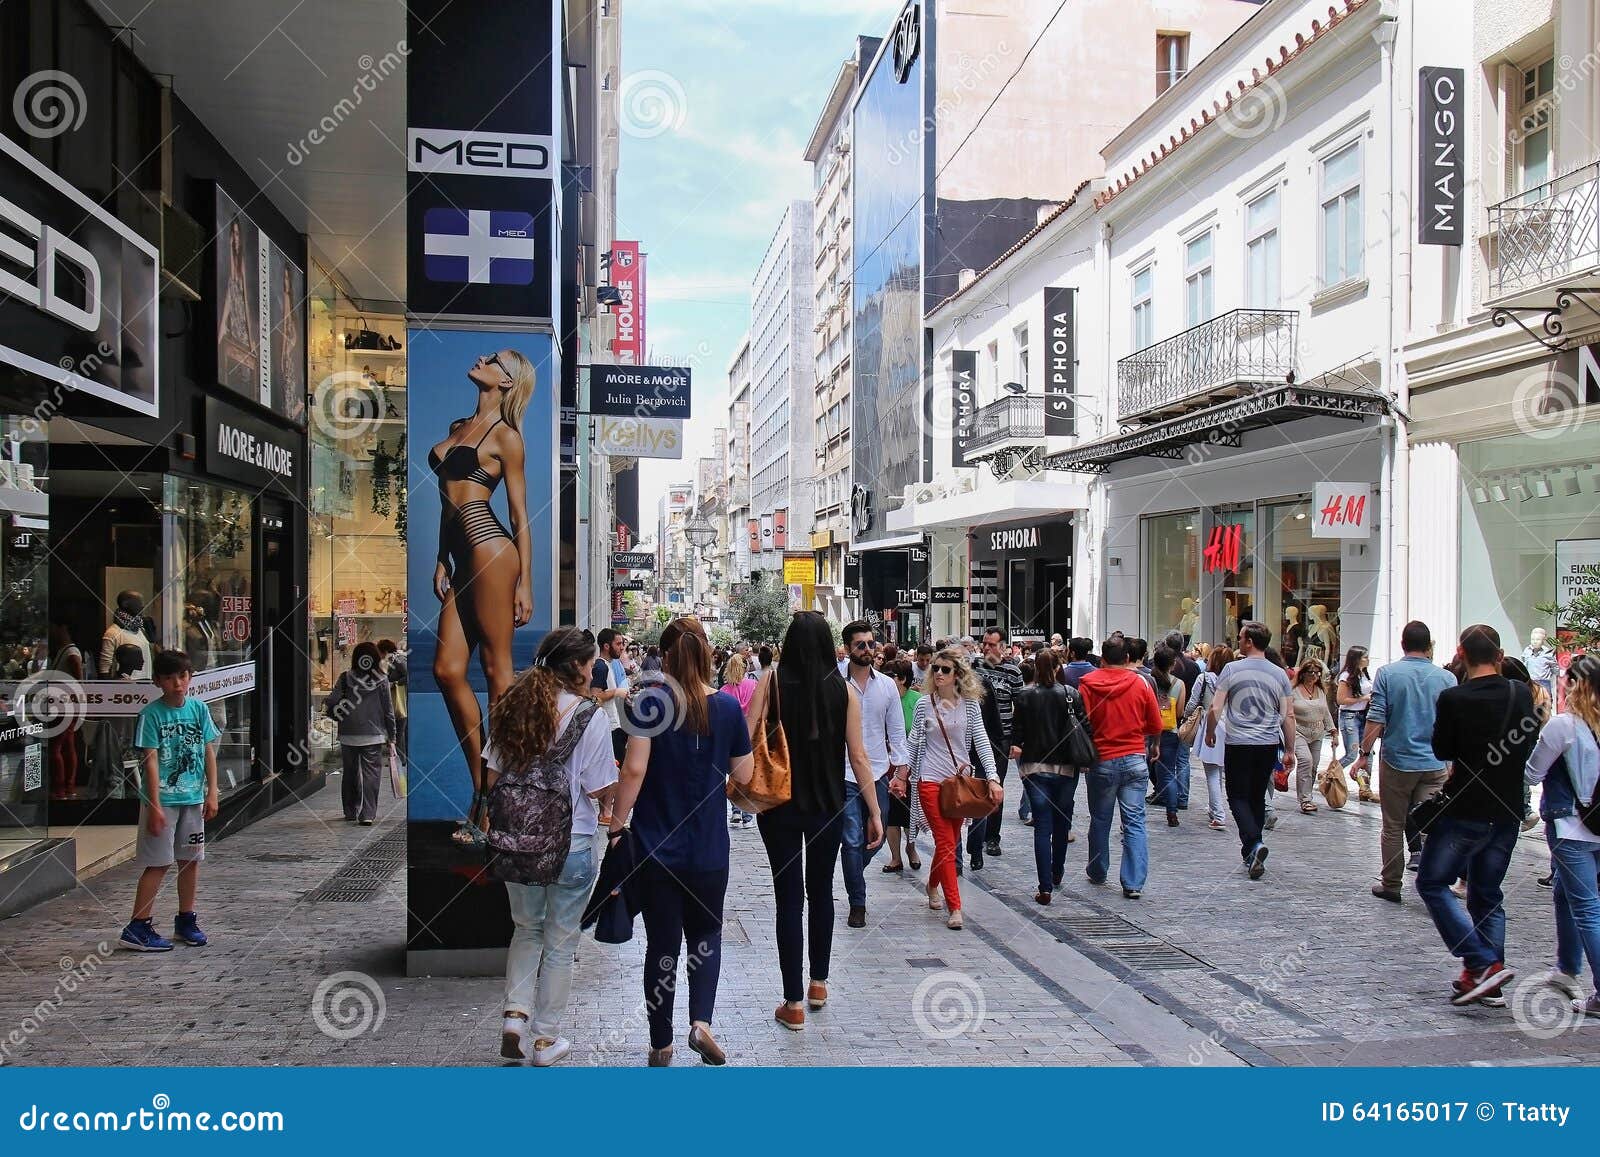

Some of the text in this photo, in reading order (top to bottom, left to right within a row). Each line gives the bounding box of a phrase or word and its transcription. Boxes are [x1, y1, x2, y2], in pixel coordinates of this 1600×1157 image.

[415, 137, 549, 170] MED
[1434, 76, 1455, 231] MANGO
[498, 229, 527, 237] MED
[618, 280, 634, 341] HOUSE
[1052, 312, 1067, 410] SEPHORA
[605, 374, 641, 385] MORE
[651, 375, 688, 386] MORE
[605, 393, 687, 408] Julia Bergovich
[958, 369, 971, 448] SEPHORA
[218, 423, 255, 464] MORE
[263, 441, 292, 477] MORE
[1321, 494, 1367, 527] H&M
[991, 527, 1037, 550] SEPHORA
[910, 548, 928, 559] Ths
[1203, 522, 1242, 575] H&M
[614, 553, 653, 564] Cameo's
[845, 554, 858, 563] Ths
[845, 587, 859, 596] Ths
[910, 589, 927, 599] Ths
[1568, 587, 1584, 597] ΓΙΑ
[59, 694, 103, 704] SALES
[107, 694, 149, 704] -50%
[188, 832, 204, 845] 32
